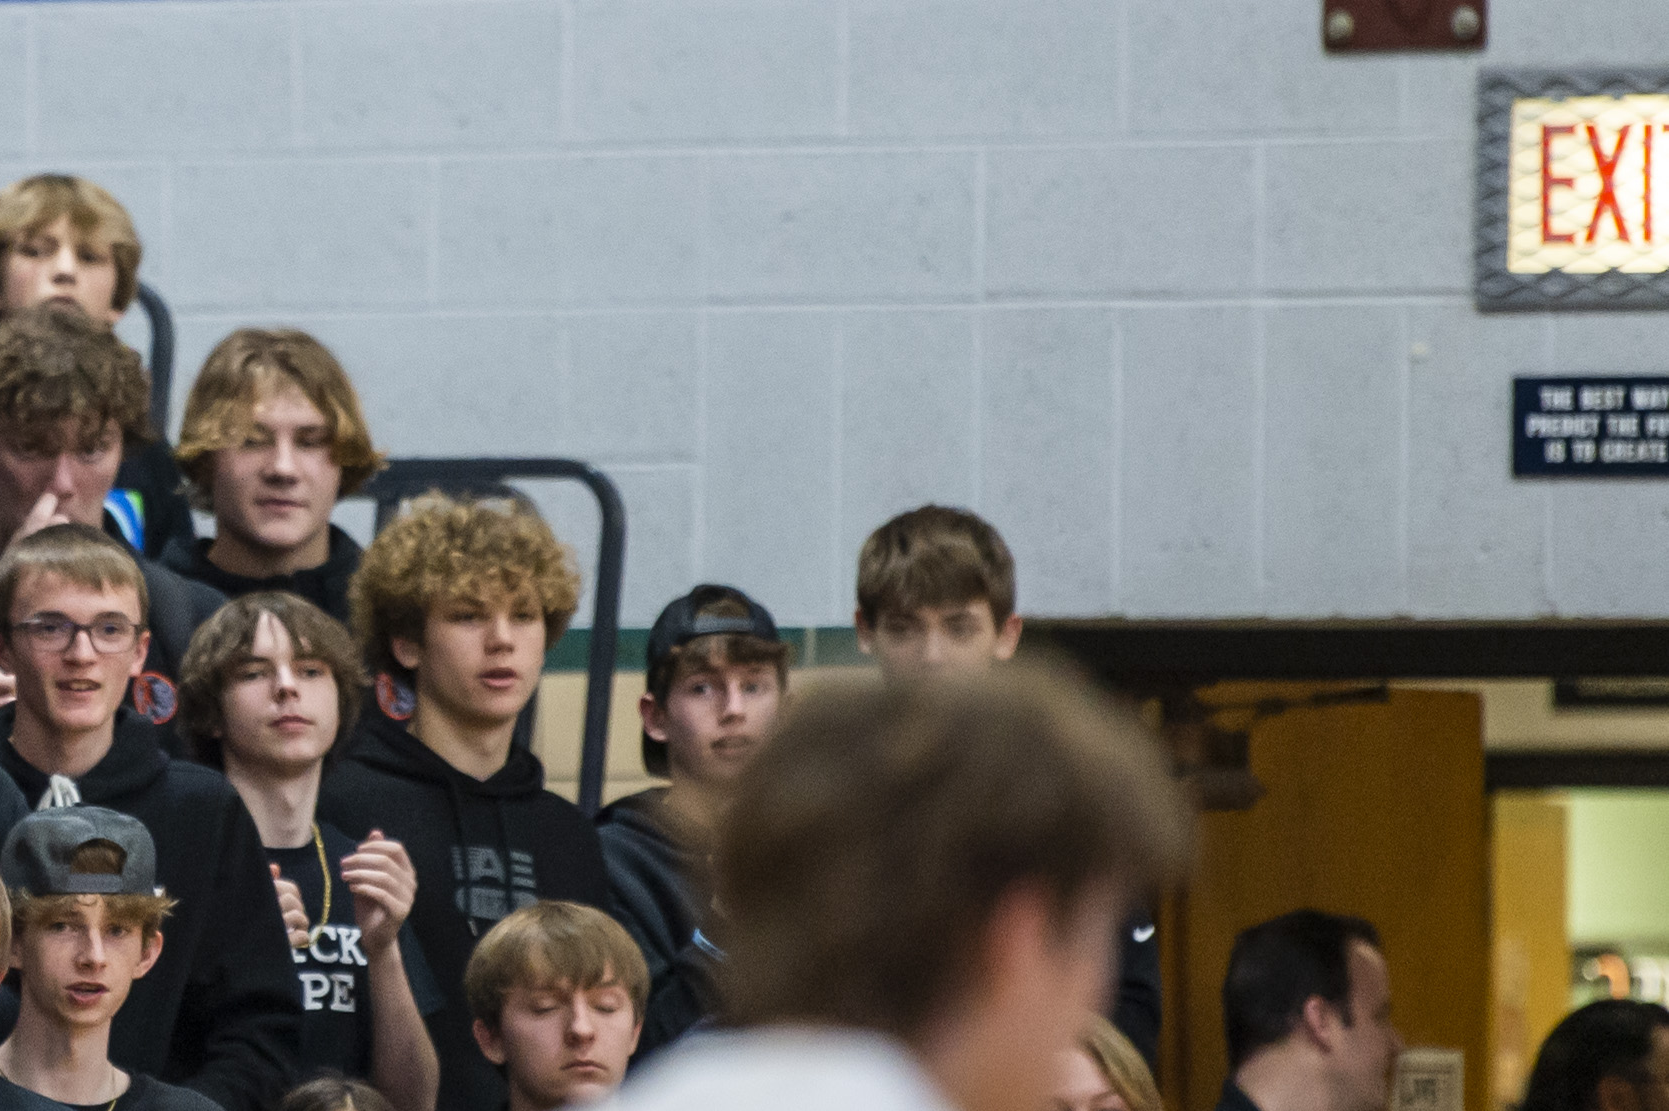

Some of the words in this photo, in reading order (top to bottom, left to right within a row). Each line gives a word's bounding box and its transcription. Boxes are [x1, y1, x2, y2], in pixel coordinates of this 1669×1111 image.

[1542, 122, 1669, 245] EXI
[1539, 386, 1574, 410] THE
[1578, 386, 1624, 410] BEST
[1524, 413, 1598, 438] PREDICT
[1606, 413, 1639, 438] THE
[1543, 440, 1565, 463] IS
[1571, 440, 1597, 463] TO
[1600, 440, 1668, 463] CREATE
[298, 972, 356, 1012] PE
